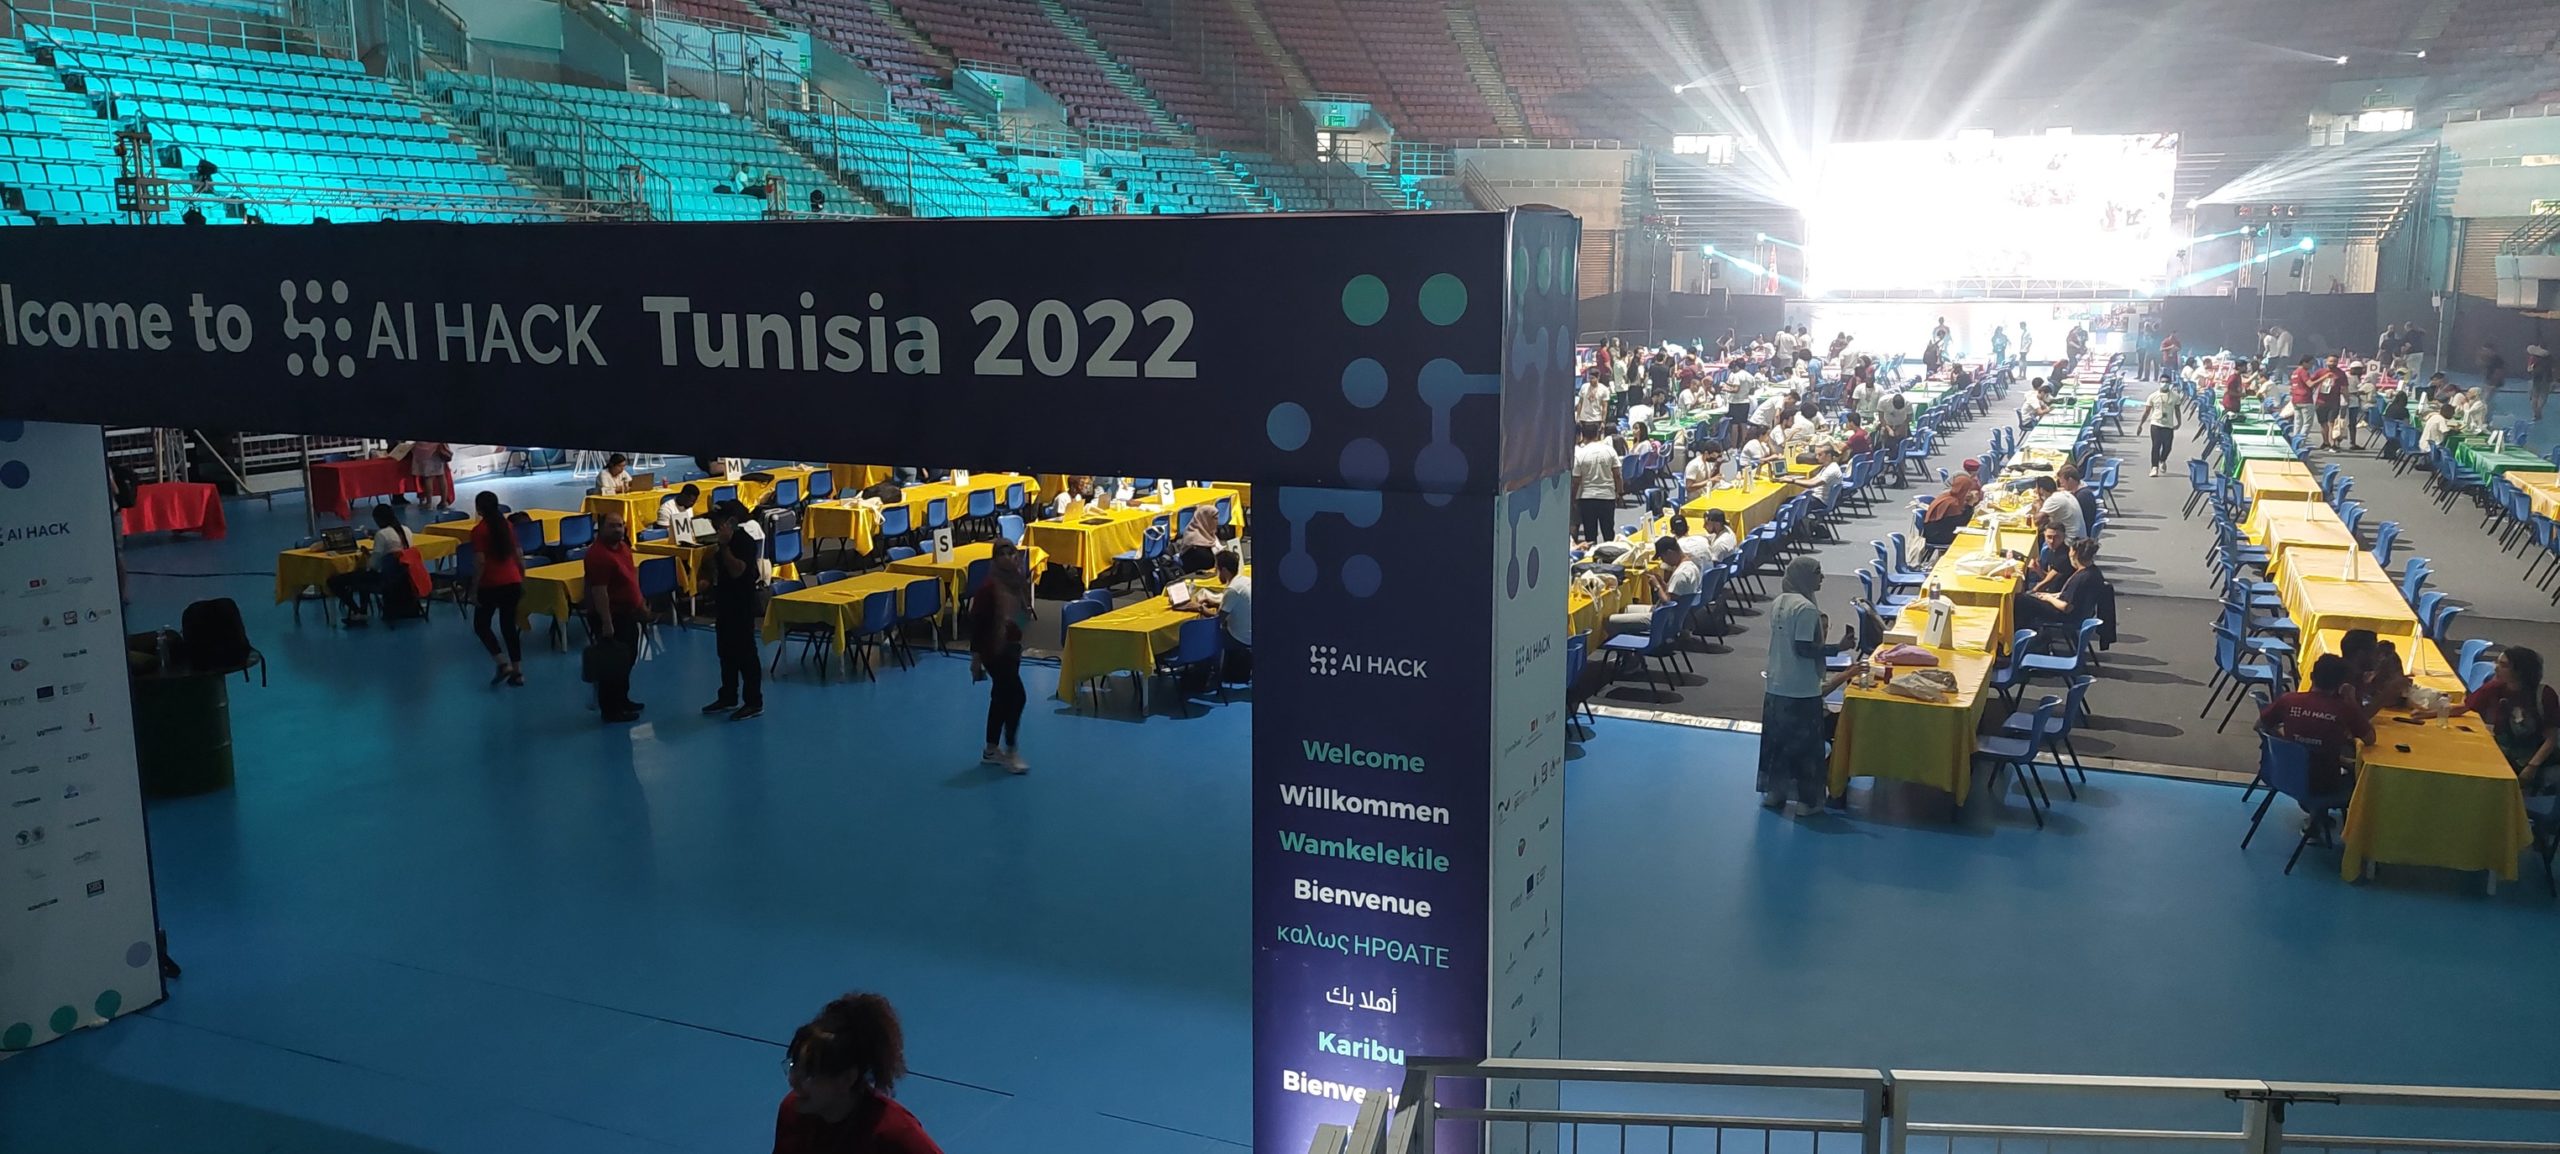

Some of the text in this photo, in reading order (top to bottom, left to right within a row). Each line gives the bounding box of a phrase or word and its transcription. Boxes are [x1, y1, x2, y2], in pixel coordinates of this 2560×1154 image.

[189, 293, 254, 353] to
[366, 301, 418, 360] AI
[434, 301, 608, 367] HACK
[642, 291, 941, 375] Tunisia
[969, 298, 1198, 379] 2022
[2370, 363, 2378, 371] D
[1788, 446, 1794, 458] T
[728, 460, 739, 473] M
[1163, 481, 1170, 495] S
[8, 522, 71, 542] AI HACK
[675, 518, 690, 535] M
[939, 535, 949, 553] S
[1933, 609, 1943, 631] T
[1533, 634, 1551, 660] HACK
[1341, 653, 1428, 679] AI HACK
[2302, 710, 2337, 722] AI HACK
[1303, 739, 1426, 774] Welcome
[1279, 784, 1450, 825] Willkommen
[1279, 830, 1450, 873] Wamkelekile
[1294, 879, 1432, 918] Bienvenue
[1325, 985, 1398, 1015] أهلا بك
[1318, 1031, 1405, 1066] Karibu
